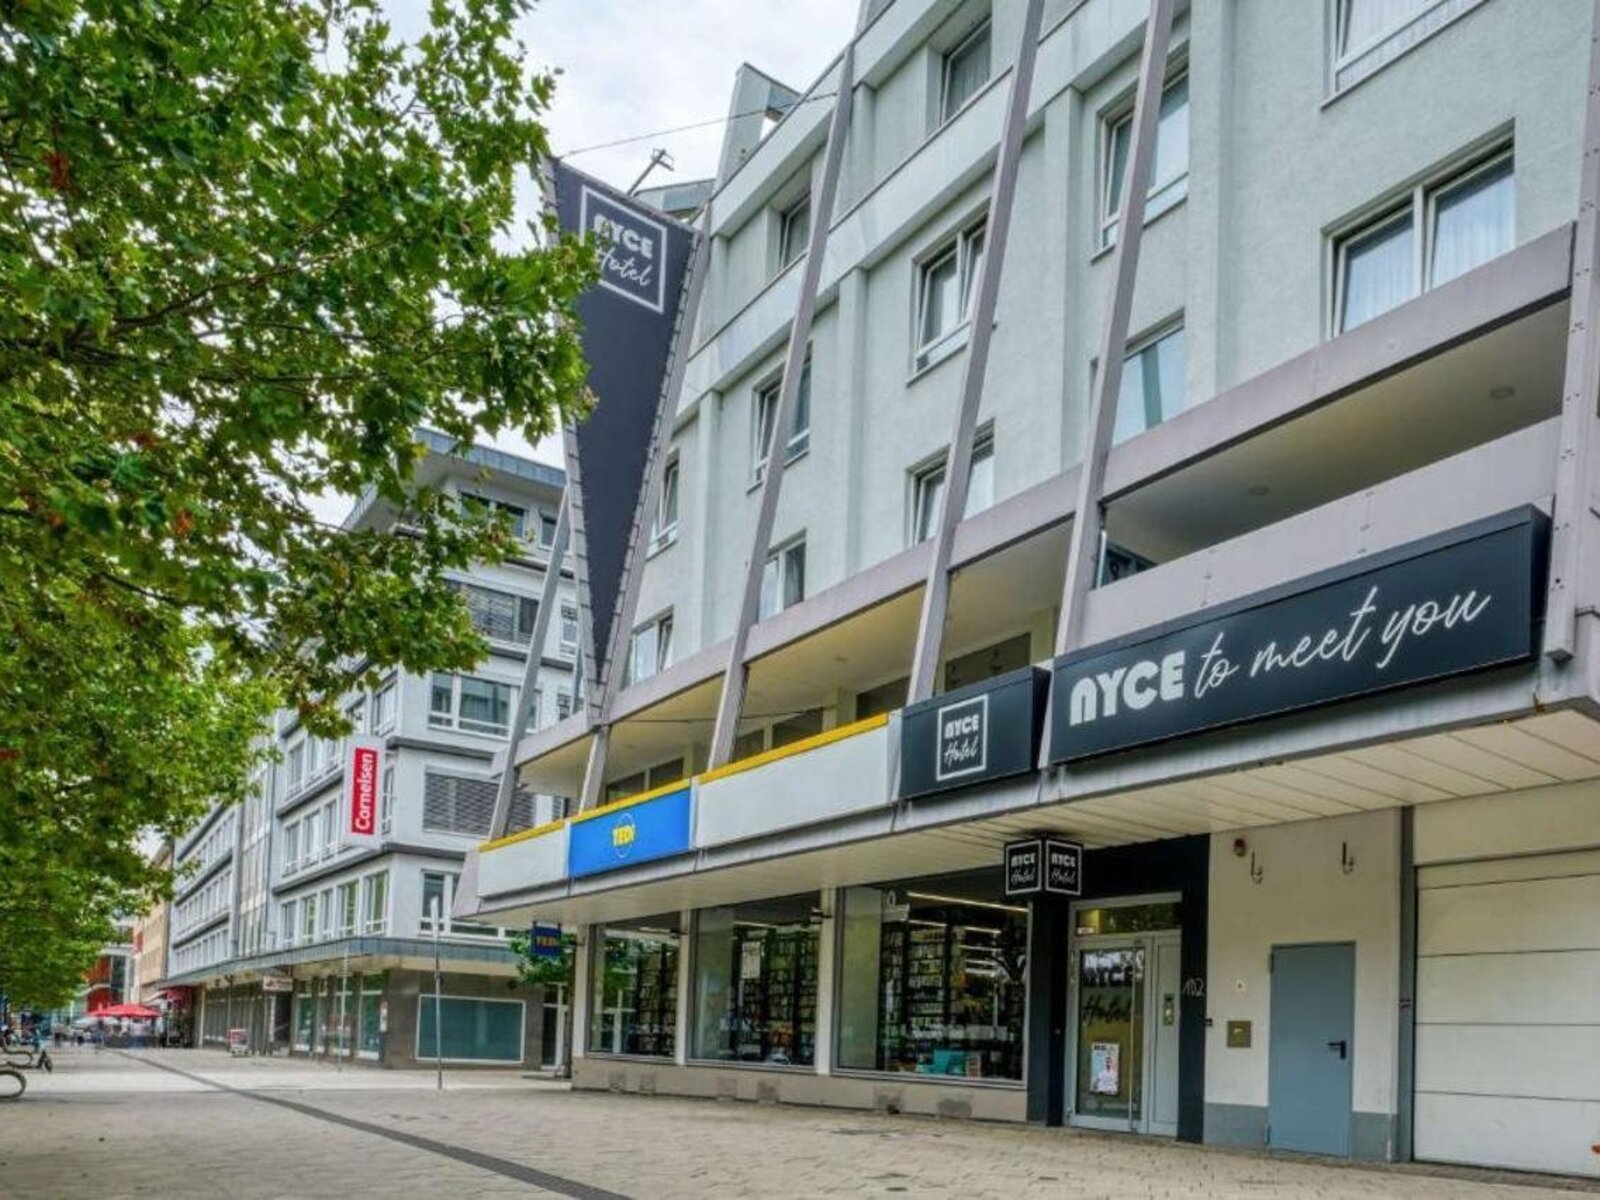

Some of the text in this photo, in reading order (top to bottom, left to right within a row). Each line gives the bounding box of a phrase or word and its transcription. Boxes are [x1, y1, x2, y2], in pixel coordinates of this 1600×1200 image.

[1194, 631, 1240, 699] to
[1250, 585, 1378, 678] meet
[1376, 589, 1491, 669] you
[355, 752, 374, 831] Cornelsen
